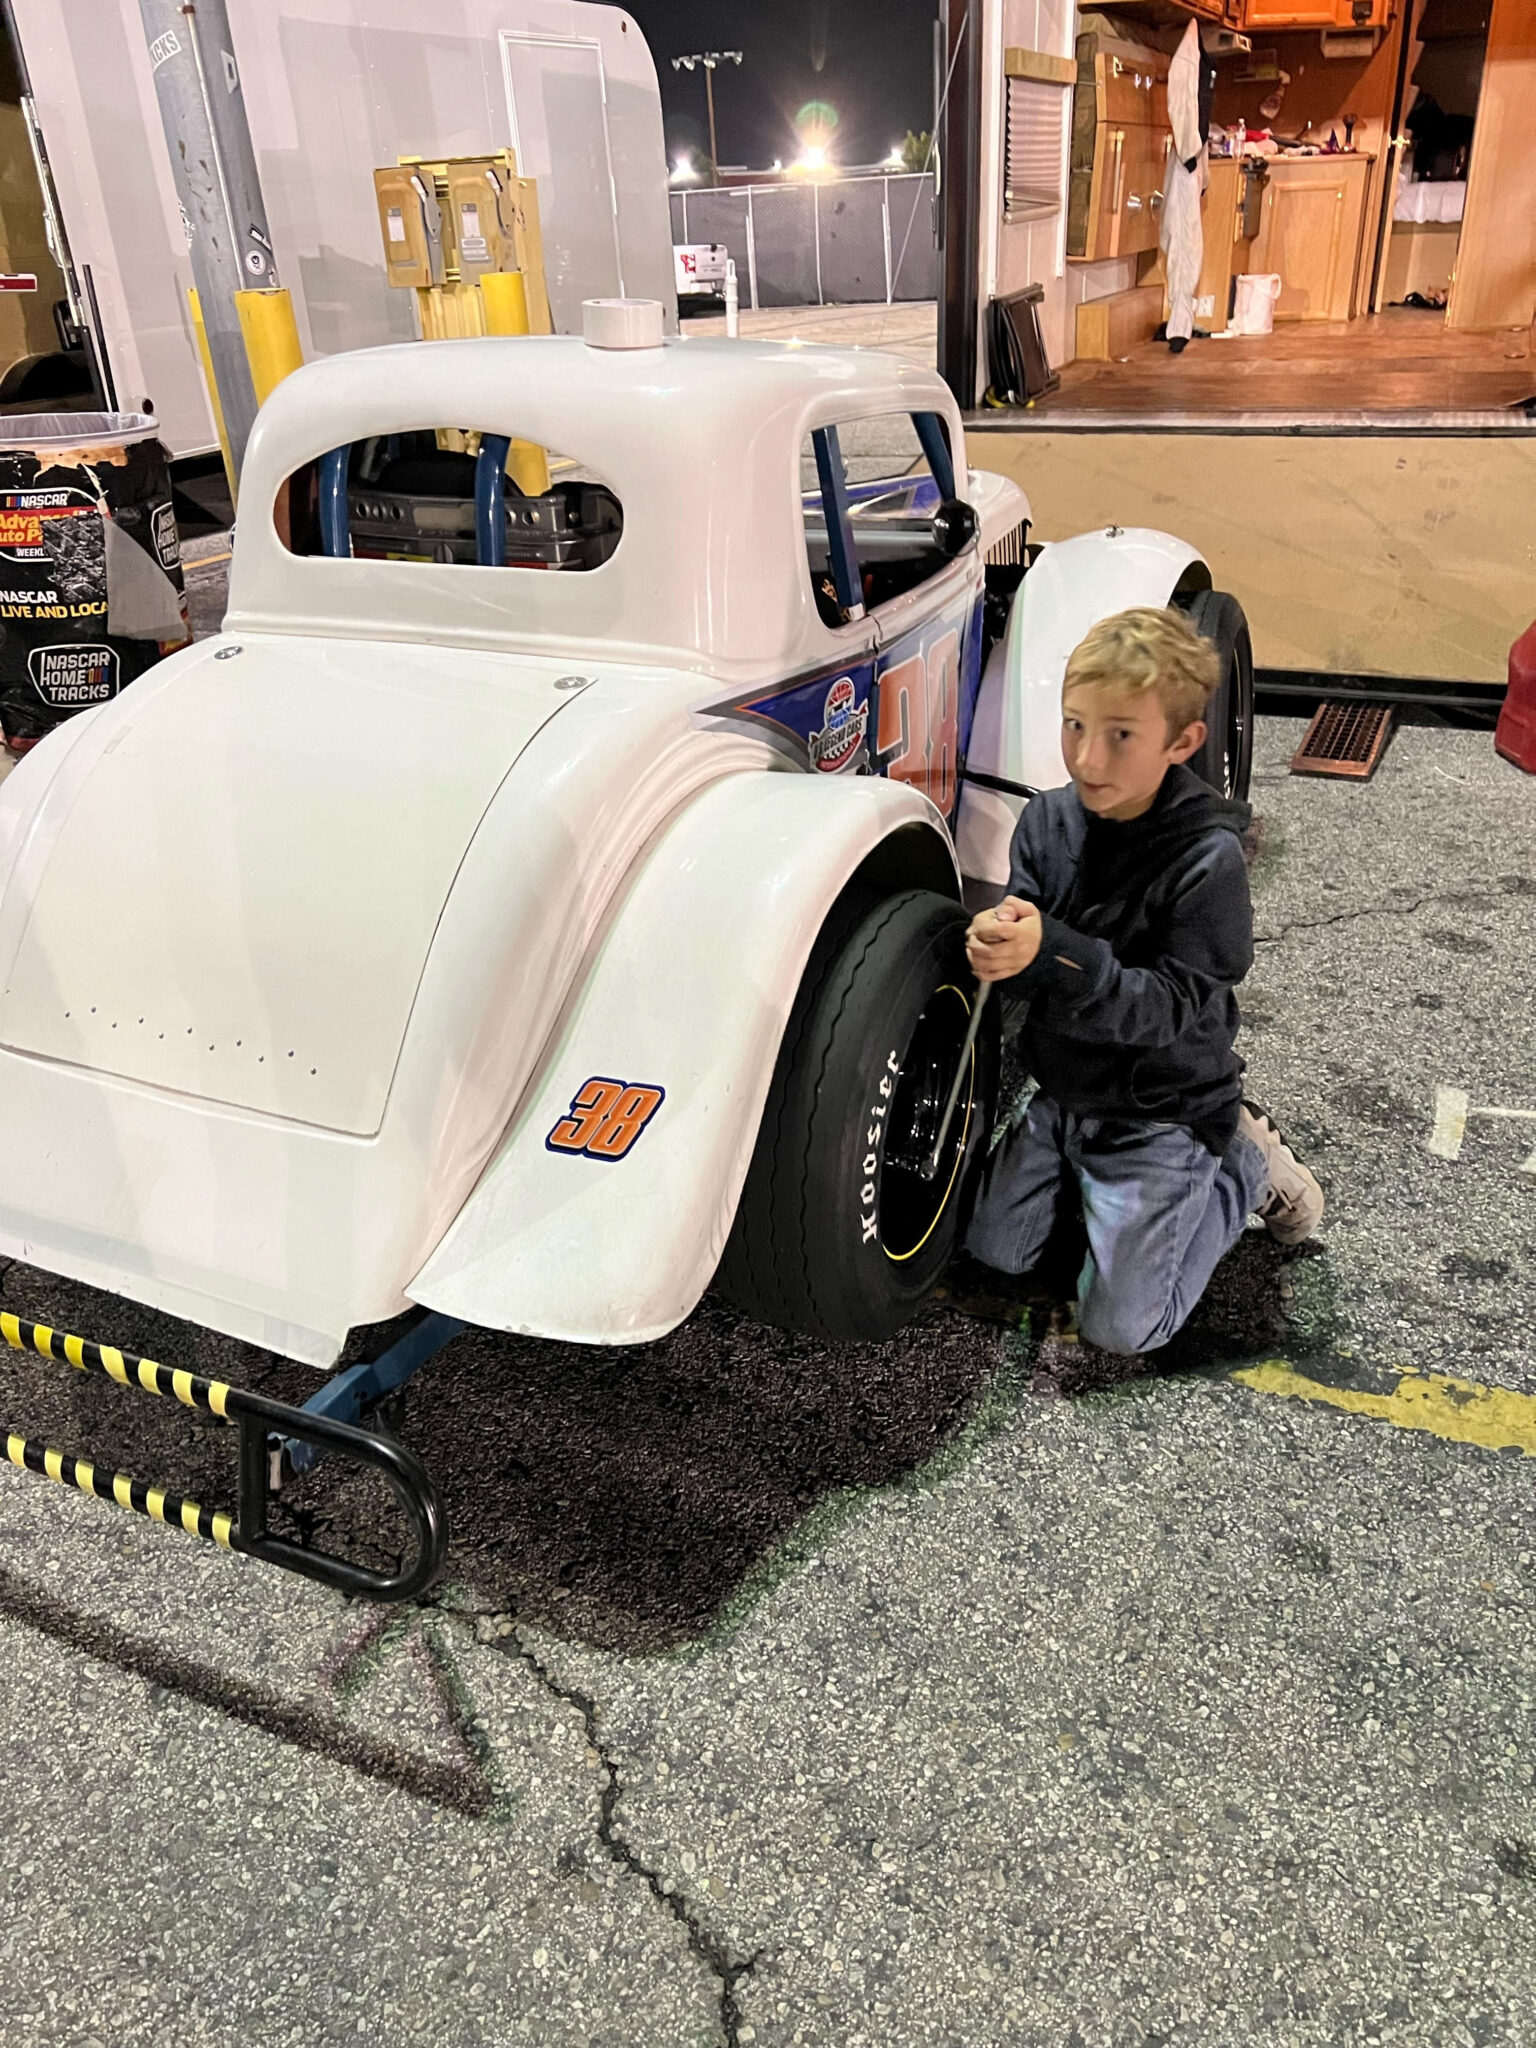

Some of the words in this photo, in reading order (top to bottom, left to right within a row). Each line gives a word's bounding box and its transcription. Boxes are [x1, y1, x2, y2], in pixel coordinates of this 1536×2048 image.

[21, 493, 68, 507] NASCAR
[0, 529, 25, 543] uto
[16, 547, 45, 557] WEEKL
[0, 591, 58, 604] NASCAR
[2, 605, 34, 618] LIVE
[36, 605, 68, 618] AND
[71, 602, 108, 616] LOCA
[46, 651, 111, 670] NASCAR
[40, 652, 87, 686] HOME
[50, 685, 110, 701] TRACKS
[546, 1077, 664, 1161] 38
